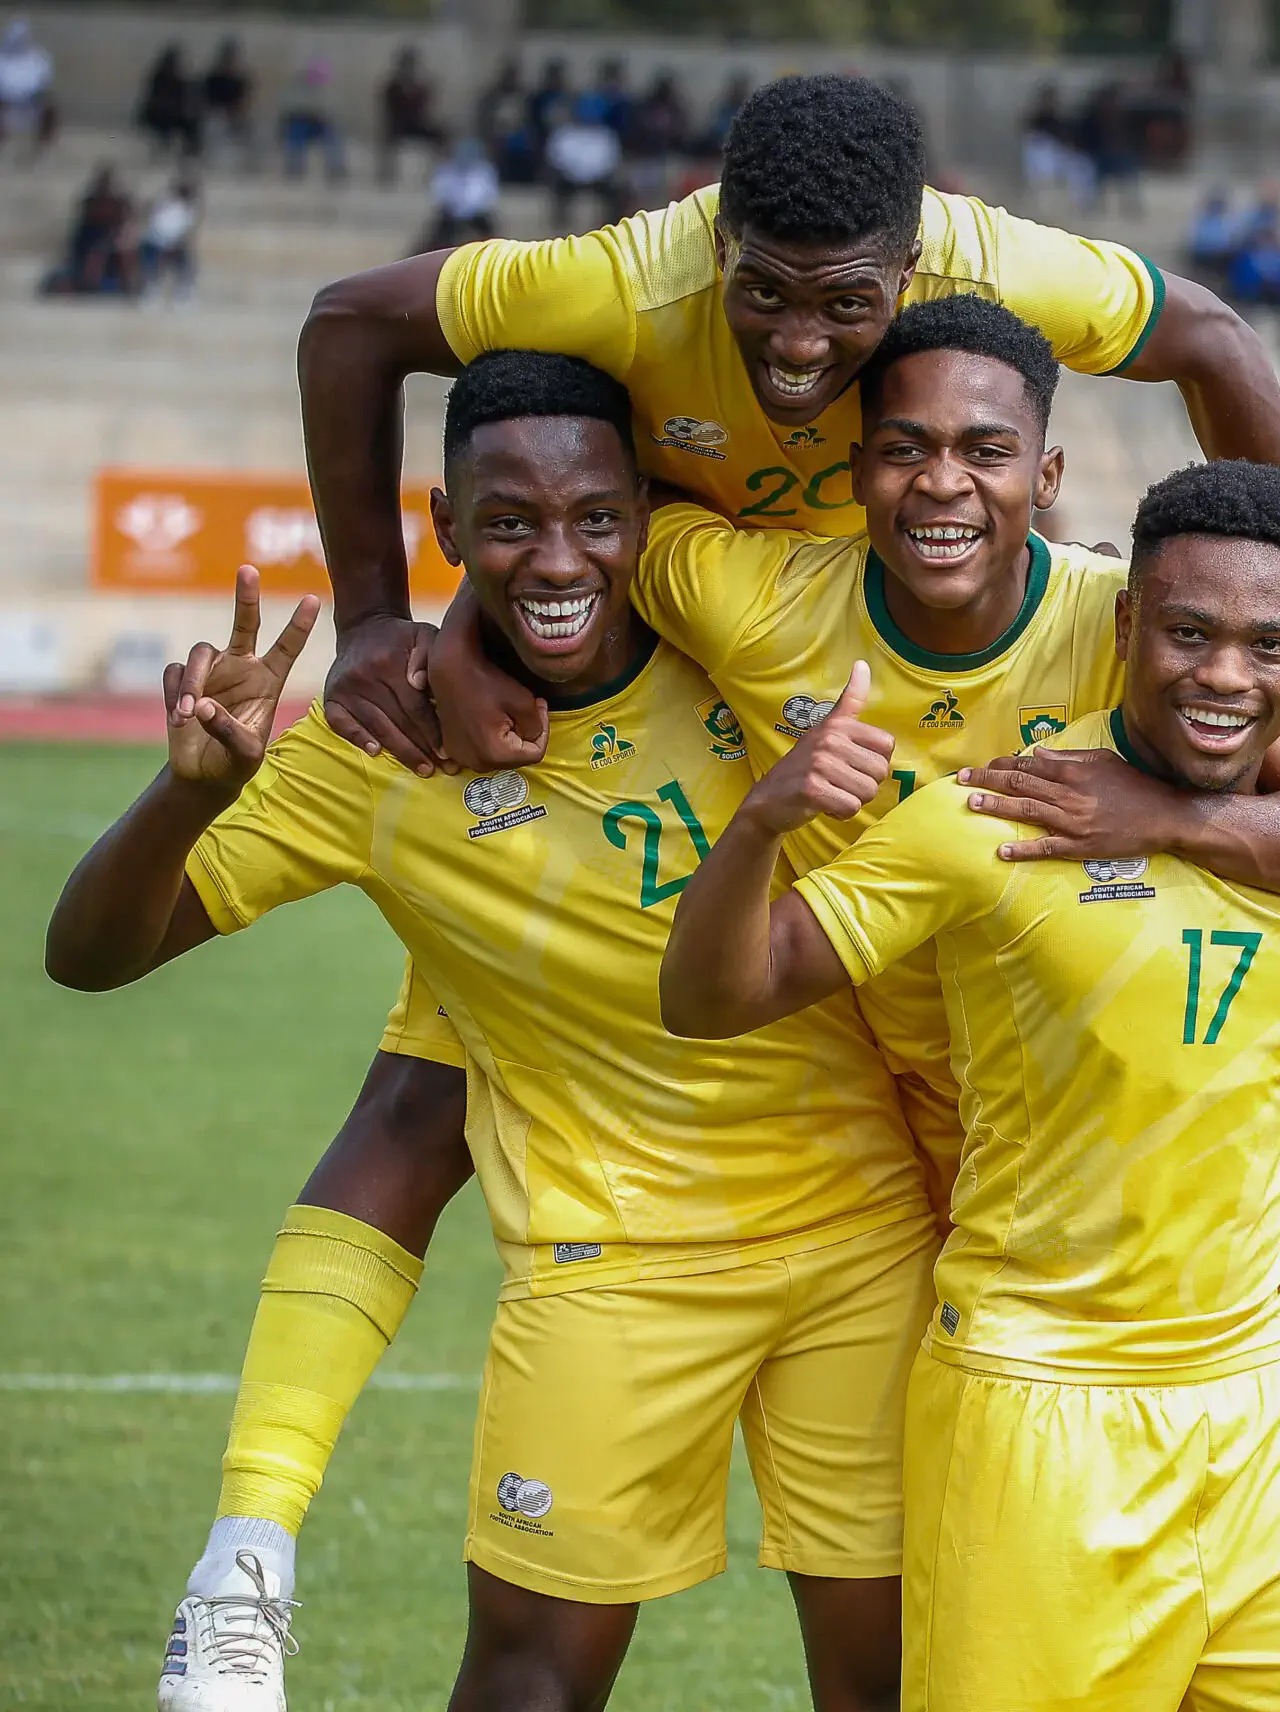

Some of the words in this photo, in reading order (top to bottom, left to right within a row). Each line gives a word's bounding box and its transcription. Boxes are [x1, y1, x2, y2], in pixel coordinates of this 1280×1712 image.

[919, 720, 926, 728] LE
[927, 720, 939, 728] COQ
[940, 720, 964, 728] SPORTIF
[591, 760, 600, 770] LE
[599, 757, 613, 767] COQ
[612, 747, 637, 763] SPORTIF
[721, 751, 741, 760] SOUTH
[470, 824, 503, 837] FOOTBALL
[504, 809, 545, 828] ASSOCIATION
[481, 816, 503, 827] SOUTH
[503, 807, 531, 821] AFRICAN
[602, 779, 712, 909] 21
[1080, 893, 1114, 902] FOOTBALL
[1115, 890, 1155, 898] ASSOCIATION
[1093, 886, 1115, 894] SOUTH
[1116, 884, 1143, 893] AFRICAN
[1182, 929, 1264, 1044] 17
[489, 1513, 513, 1528] FOOTBALL
[514, 1524, 554, 1537] ASSOCIATION
[498, 1511, 516, 1522] SOUTH
[516, 1518, 542, 1529] AFRICAN
